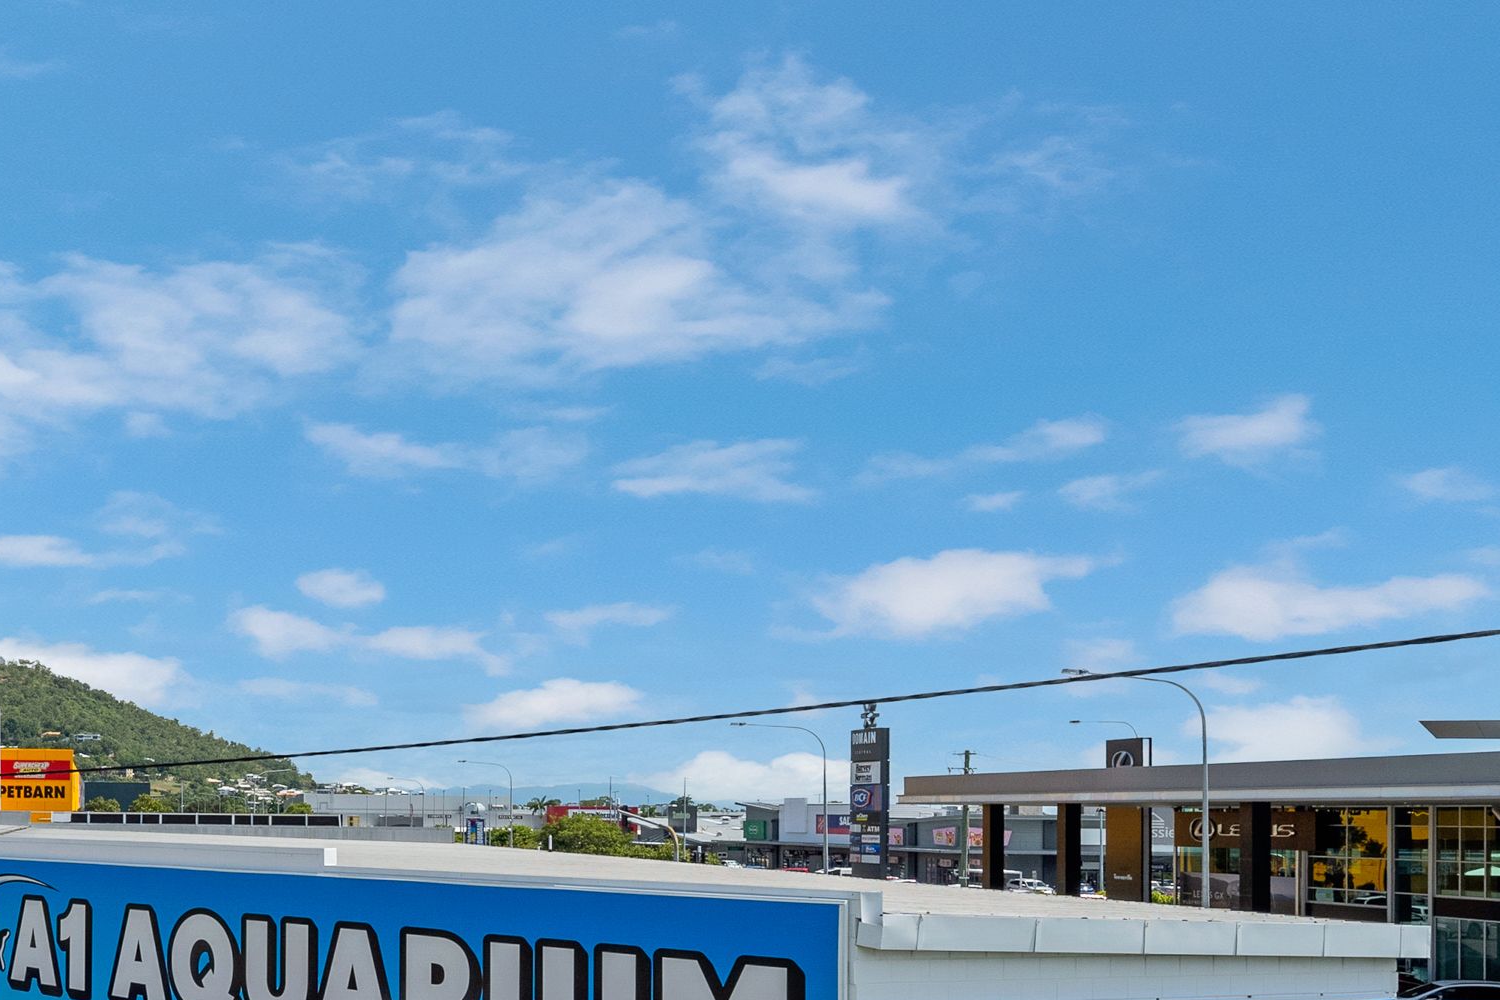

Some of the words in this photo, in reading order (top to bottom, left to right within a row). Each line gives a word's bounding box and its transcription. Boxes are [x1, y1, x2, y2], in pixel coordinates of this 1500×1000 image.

[852, 731, 876, 744] DOMAIN
[0, 785, 66, 799] PETBARN
[1152, 826, 1174, 839] ssie
[8, 893, 93, 1000] A1
